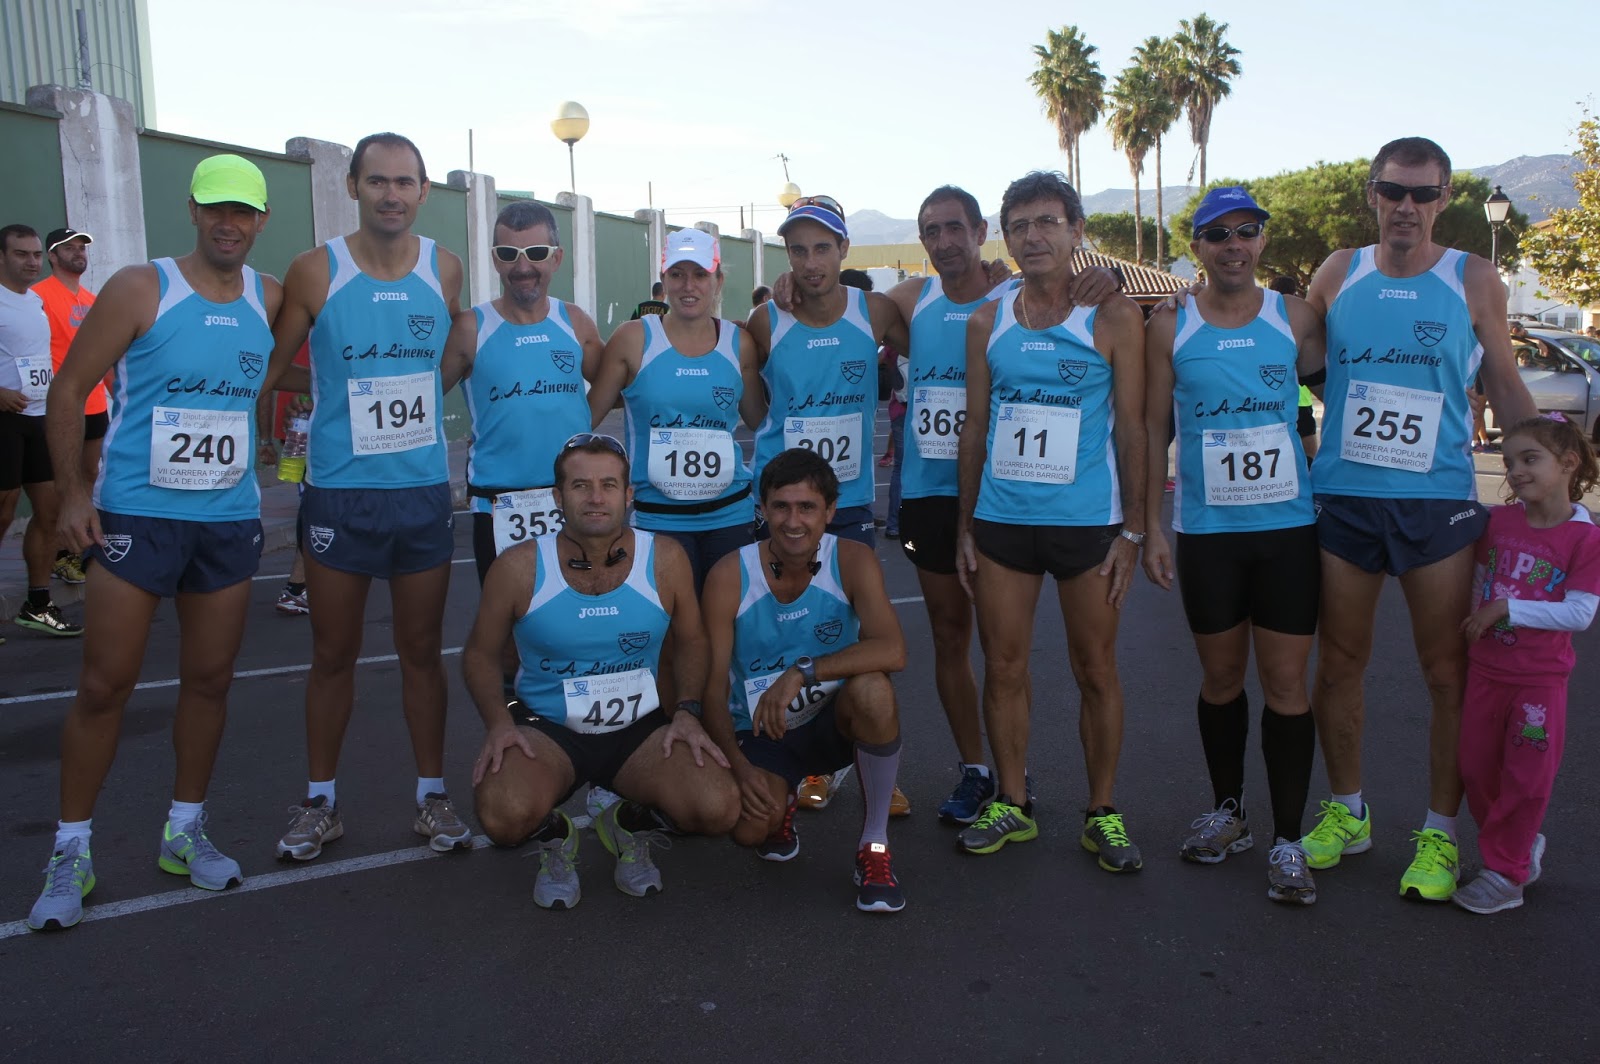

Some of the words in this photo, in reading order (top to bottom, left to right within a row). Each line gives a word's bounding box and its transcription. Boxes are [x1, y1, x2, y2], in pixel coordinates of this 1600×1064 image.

[166, 378, 260, 399] C.A.Linens
[368, 396, 426, 430] 194
[649, 413, 728, 429] C.A.Linen
[918, 408, 968, 437] 368
[1353, 407, 1423, 445] 255
[359, 442, 381, 451] VILLA
[382, 442, 392, 450] DE
[394, 440, 408, 449] LOS
[408, 434, 433, 446] BARRIOS
[370, 433, 406, 443] CARRERA
[406, 427, 433, 438] POPULAR
[1013, 427, 1048, 458] 11
[168, 432, 236, 466] 240
[1352, 442, 1389, 454] CARRERA
[1390, 447, 1428, 460] POPULAR
[664, 449, 722, 478] 189
[1003, 460, 1034, 469] CARRERA
[1034, 463, 1070, 472] POPULAR
[1221, 448, 1281, 482] 187
[1344, 449, 1360, 458] VILLA
[1360, 451, 1372, 460] DE
[1373, 453, 1389, 463] LOS
[1391, 456, 1426, 468] BARRIOS
[156, 476, 181, 484] VILLA
[181, 478, 192, 486] DE
[193, 478, 210, 486] LOS
[157, 467, 168, 475] VII
[169, 468, 208, 477] CARRERA
[837, 470, 857, 479] ARRIOS
[1020, 470, 1035, 478] LOS
[1036, 472, 1069, 480] BARRIOS
[663, 481, 697, 489] CARRERA
[1222, 484, 1259, 493] CARRERA
[1260, 480, 1294, 491] POPULAR
[1211, 494, 1232, 502] VILLA
[1233, 494, 1245, 502] DE
[1246, 493, 1261, 501] LOS
[1263, 488, 1295, 500] BARRIOS
[508, 509, 565, 542] 353
[787, 682, 826, 713] 06
[581, 693, 643, 727] 427
